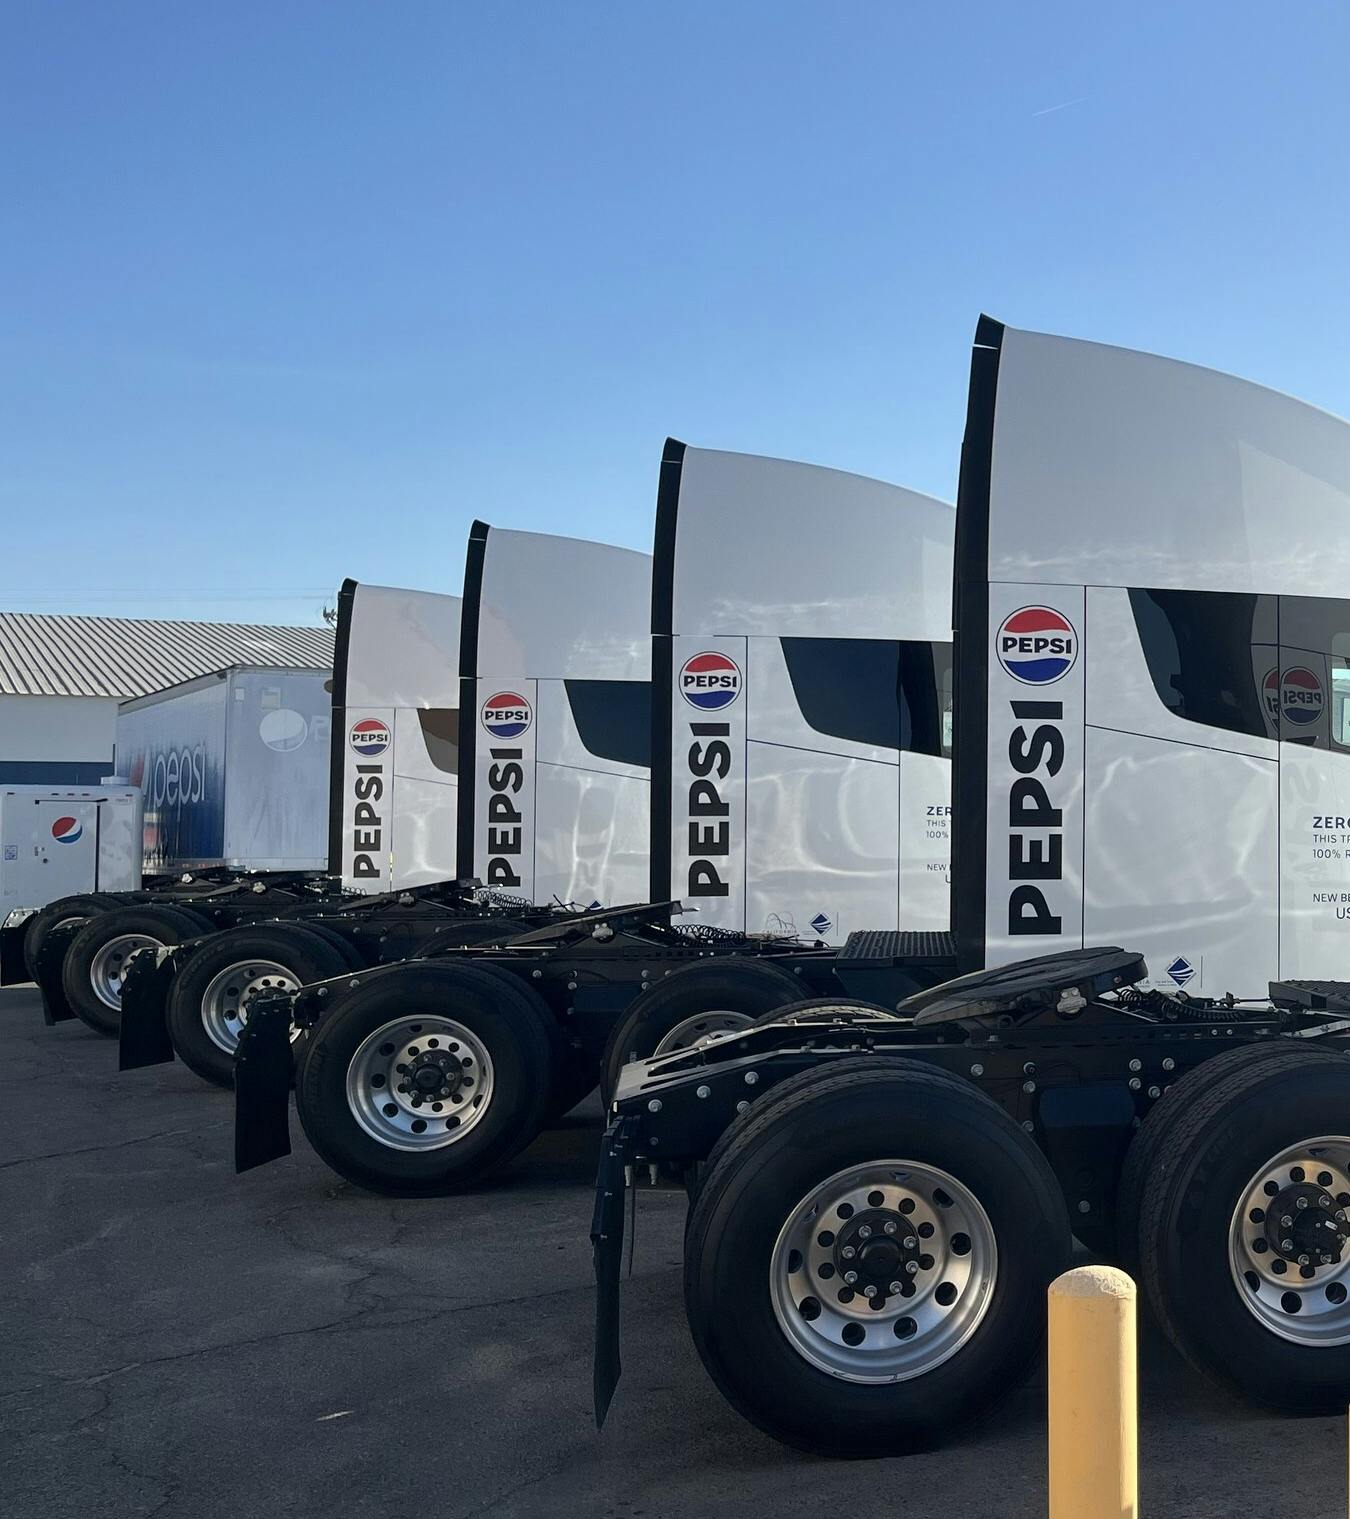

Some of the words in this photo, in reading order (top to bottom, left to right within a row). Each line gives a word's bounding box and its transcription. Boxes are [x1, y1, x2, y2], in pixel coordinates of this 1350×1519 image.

[1002, 637, 1072, 655] PEPSI
[684, 675, 737, 688] PEPSI
[485, 710, 528, 721] PEPSI
[352, 734, 388, 742] PEPSI
[154, 744, 206, 809] pepsi
[488, 748, 523, 887] PEPSI
[688, 723, 731, 897] PEPSI
[1008, 700, 1064, 935] PEPSI
[353, 764, 383, 878] PEPSI
[1313, 835, 1337, 843] THIS
[1313, 849, 1341, 858] 100%
[1313, 894, 1337, 902] NEW
